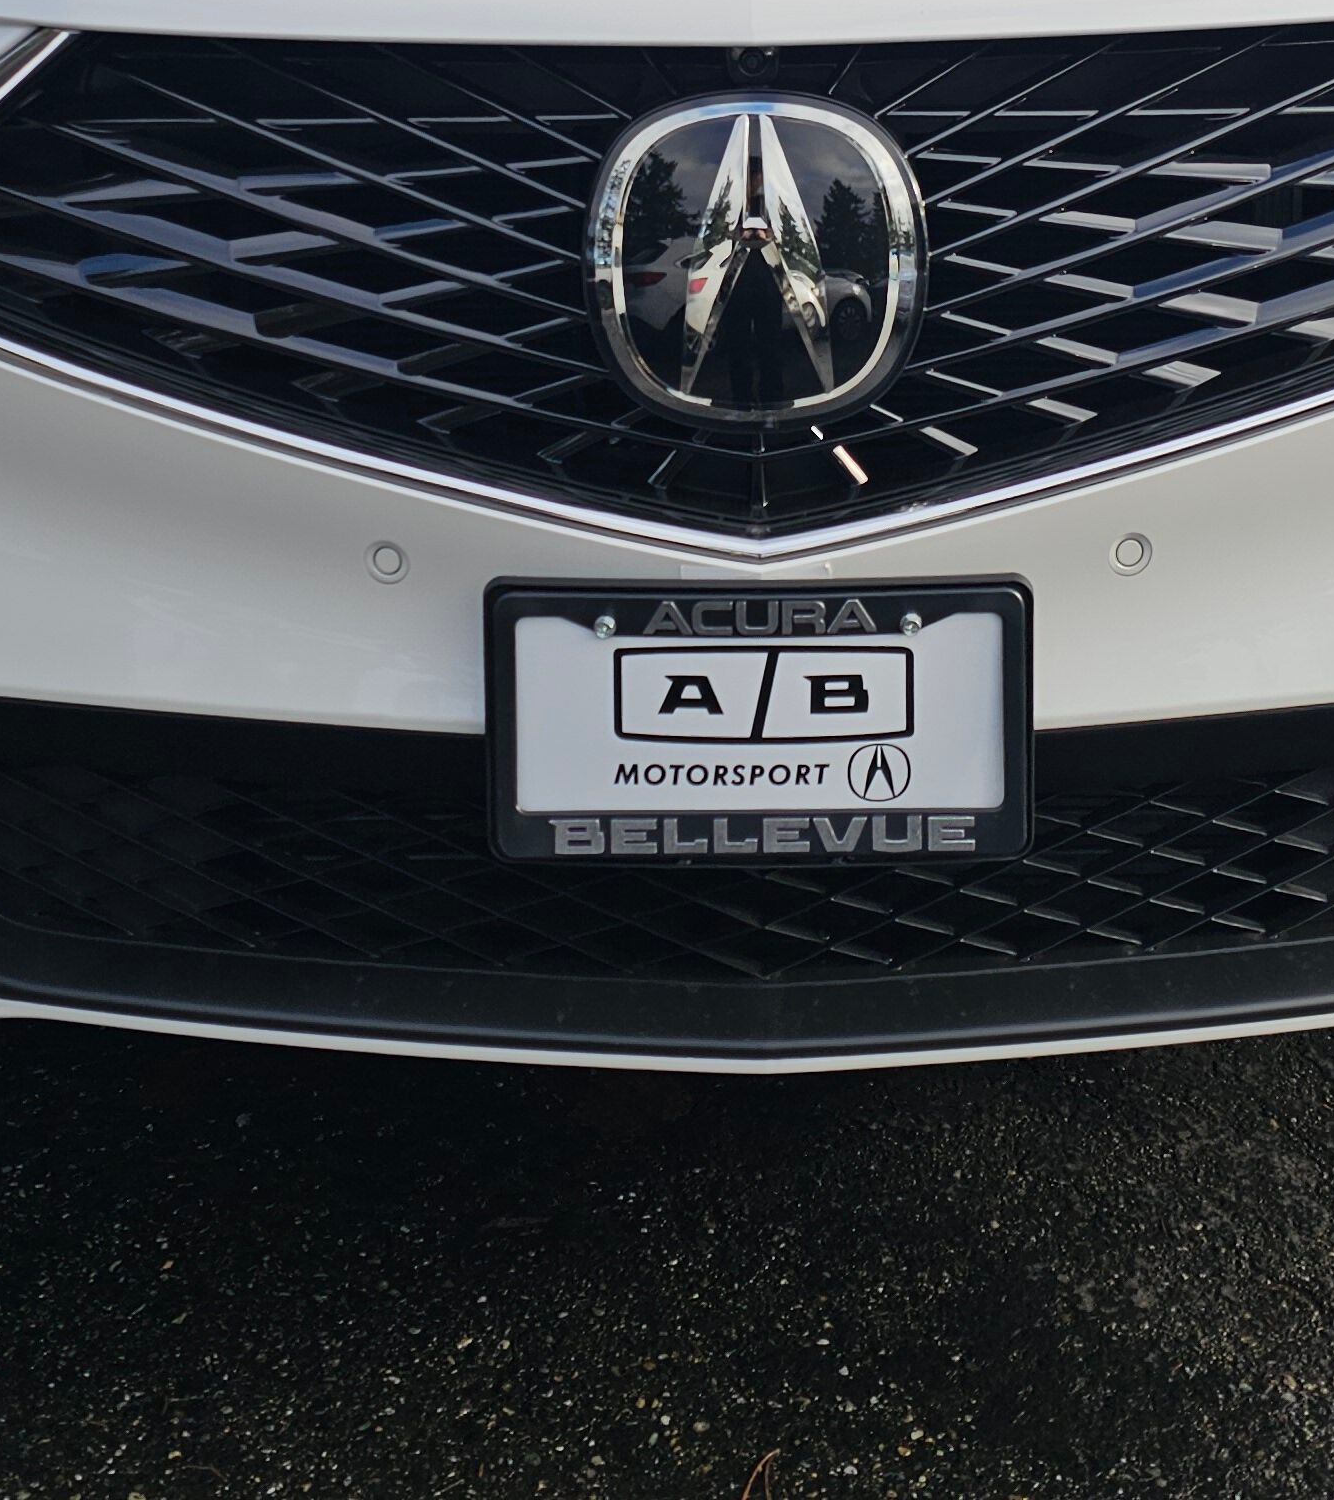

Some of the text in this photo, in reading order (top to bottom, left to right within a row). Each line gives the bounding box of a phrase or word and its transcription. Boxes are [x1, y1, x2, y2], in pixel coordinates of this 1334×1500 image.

[642, 599, 878, 636] ACURA
[613, 762, 831, 787] MOTORSPORT
[548, 814, 977, 855] BELLEVUE
